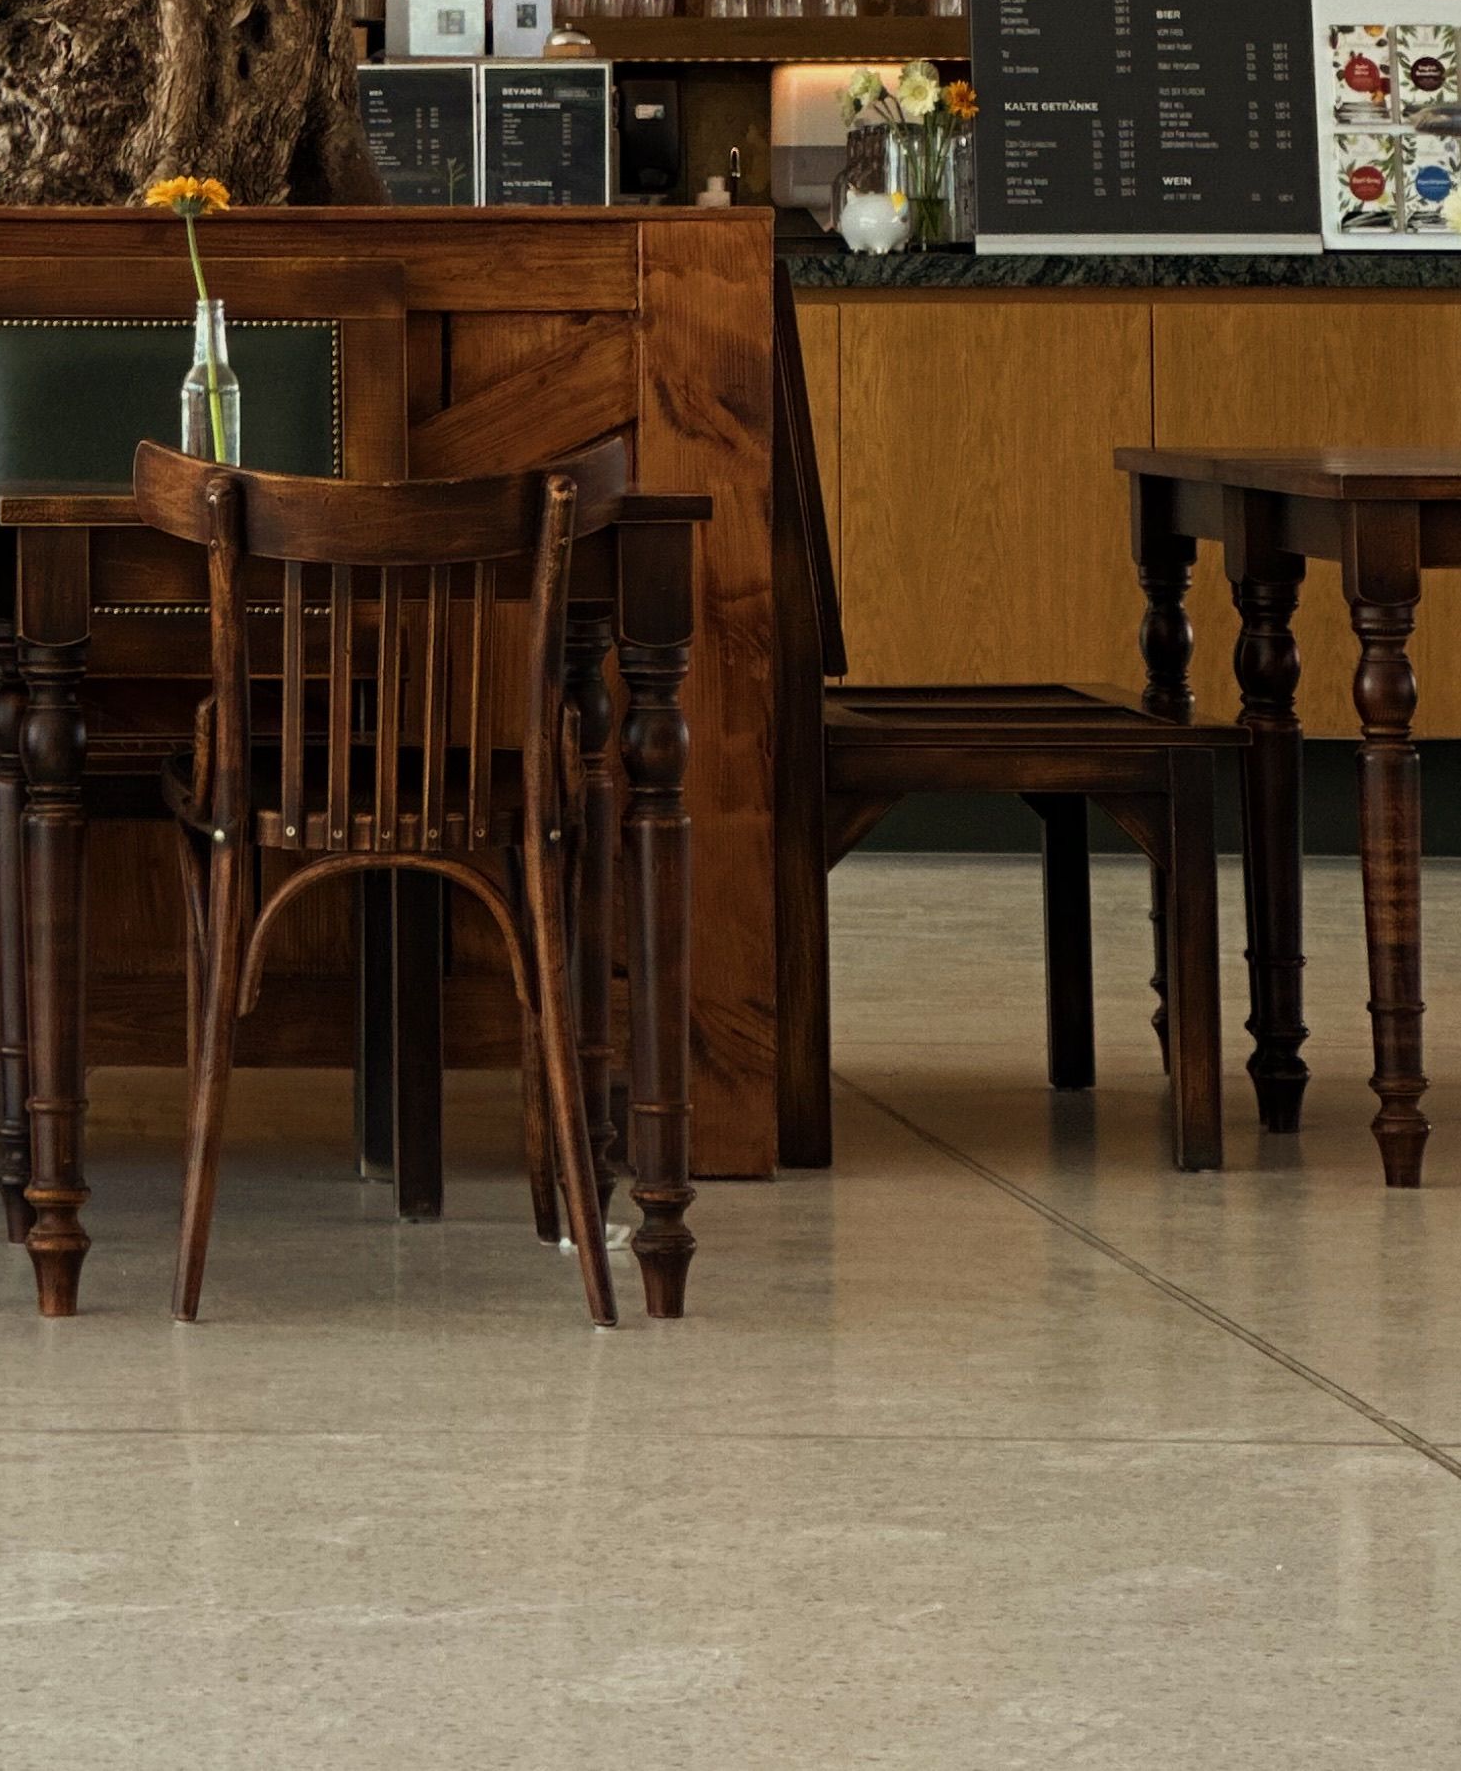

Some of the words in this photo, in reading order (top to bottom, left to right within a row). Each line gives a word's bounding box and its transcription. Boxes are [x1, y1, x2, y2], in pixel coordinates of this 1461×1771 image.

[1156, 10, 1181, 19] BIER
[1004, 102, 1039, 111] KALTE
[1042, 100, 1099, 111] GETRÄNKE
[1162, 177, 1192, 186] WEIN
